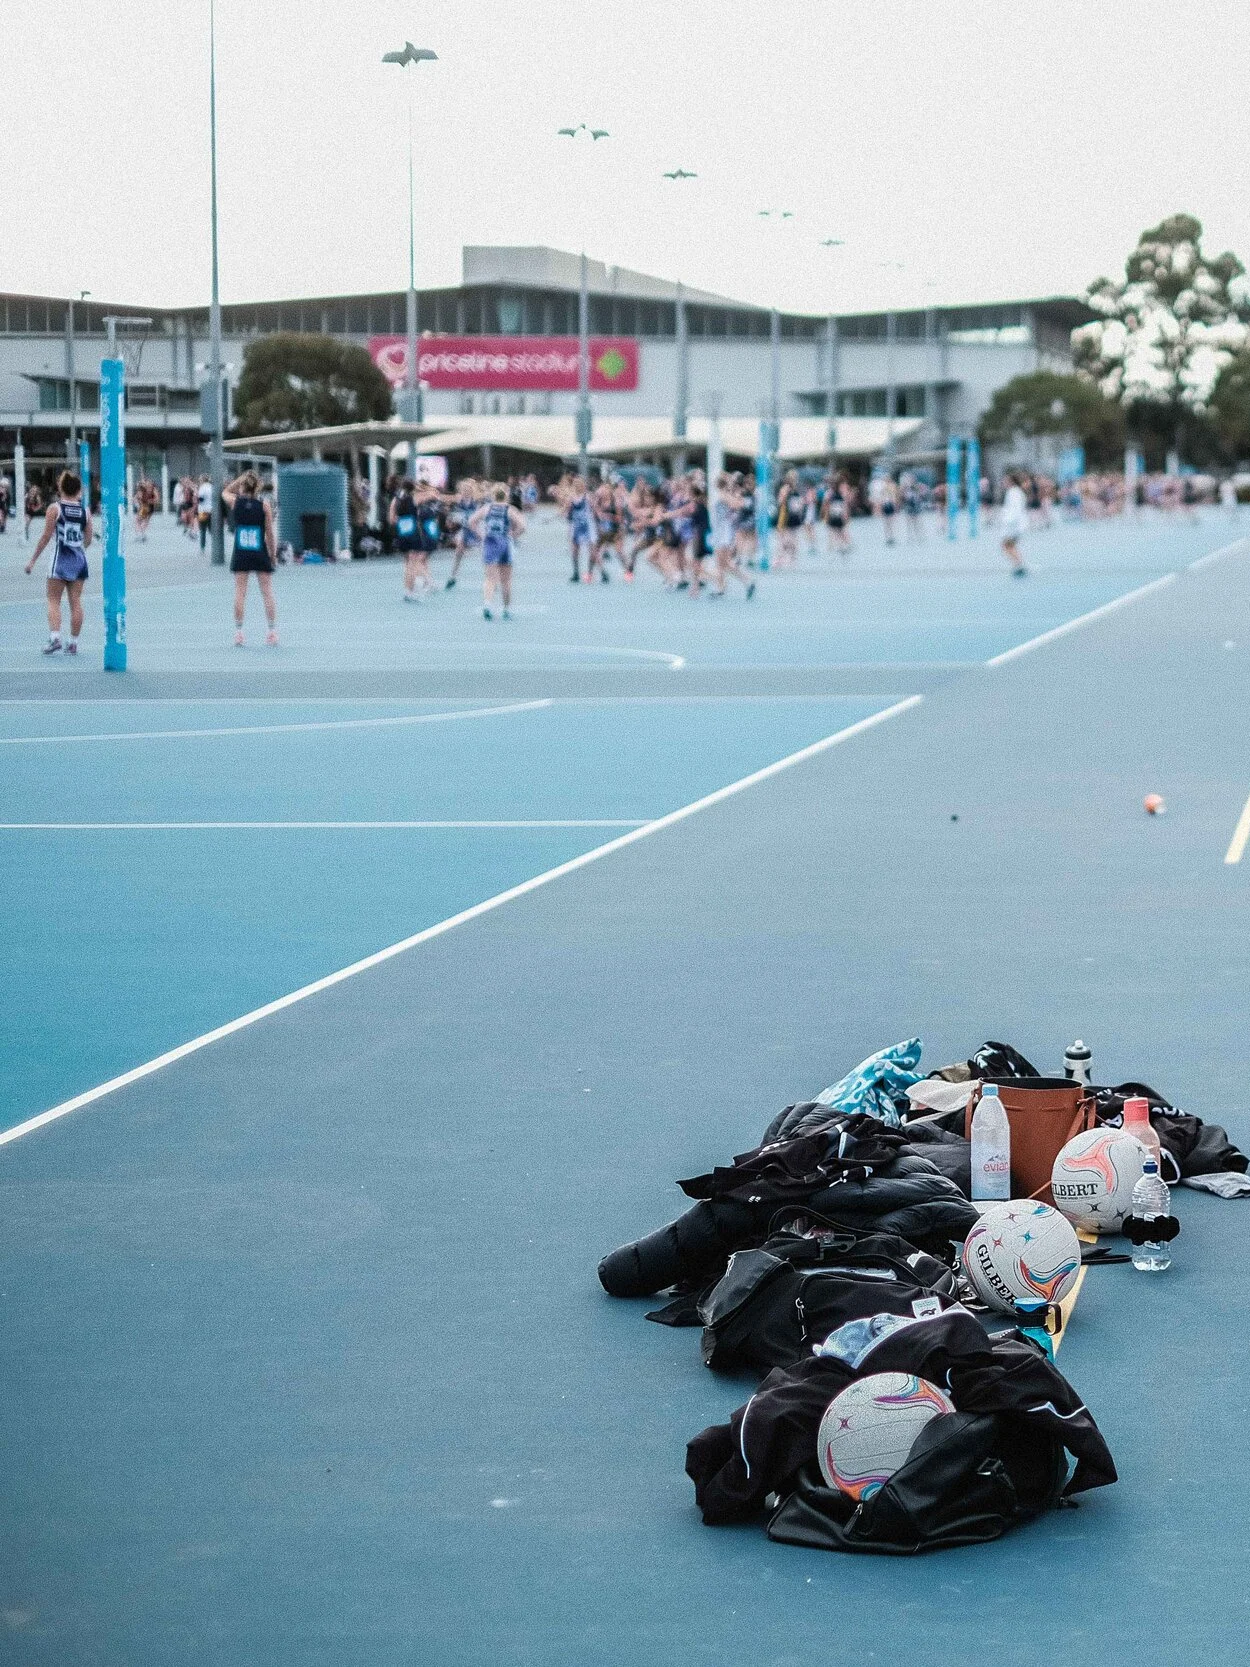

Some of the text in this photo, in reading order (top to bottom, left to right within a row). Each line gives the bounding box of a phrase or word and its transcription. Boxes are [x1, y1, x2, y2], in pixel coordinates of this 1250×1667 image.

[510, 351, 580, 374] stadiu
[1053, 1182, 1098, 1197] LBERT
[977, 1243, 1019, 1307] GILBER
